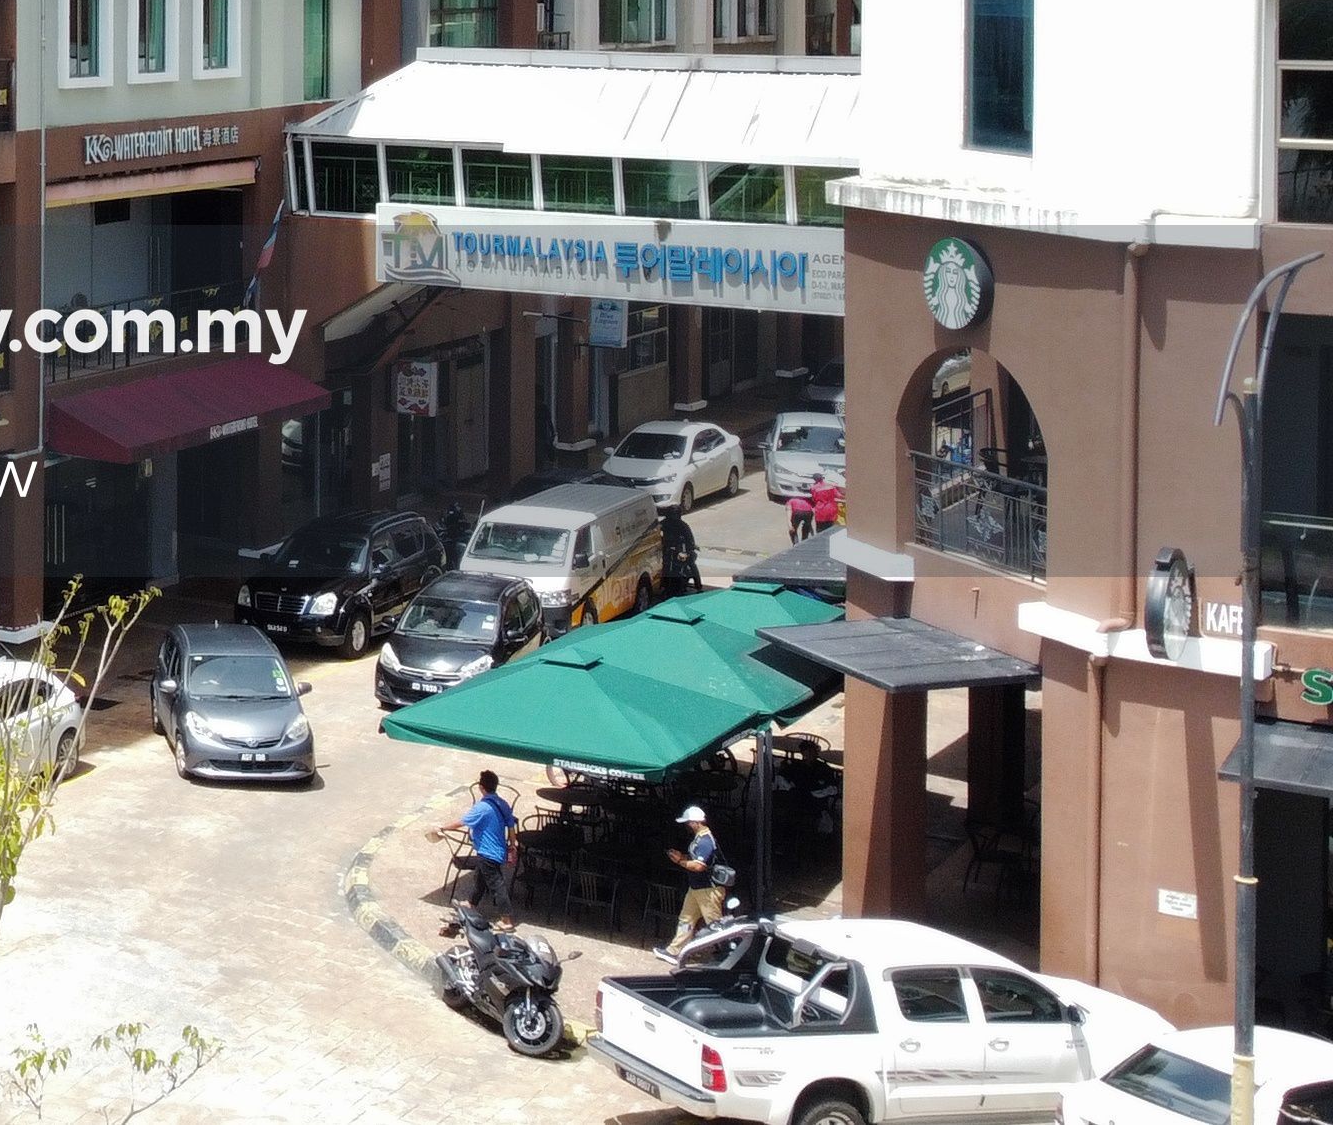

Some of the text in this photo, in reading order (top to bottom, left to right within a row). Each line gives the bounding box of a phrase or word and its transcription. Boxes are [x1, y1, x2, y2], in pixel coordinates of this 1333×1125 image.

[113, 127, 174, 162] WATERFRONT
[175, 125, 203, 154] HOTEL
[452, 231, 608, 263] TOURMALAYSIA
[614, 241, 807, 290] 투어말레이시아
[553, 758, 646, 781] STARBUCKS COFFEE
